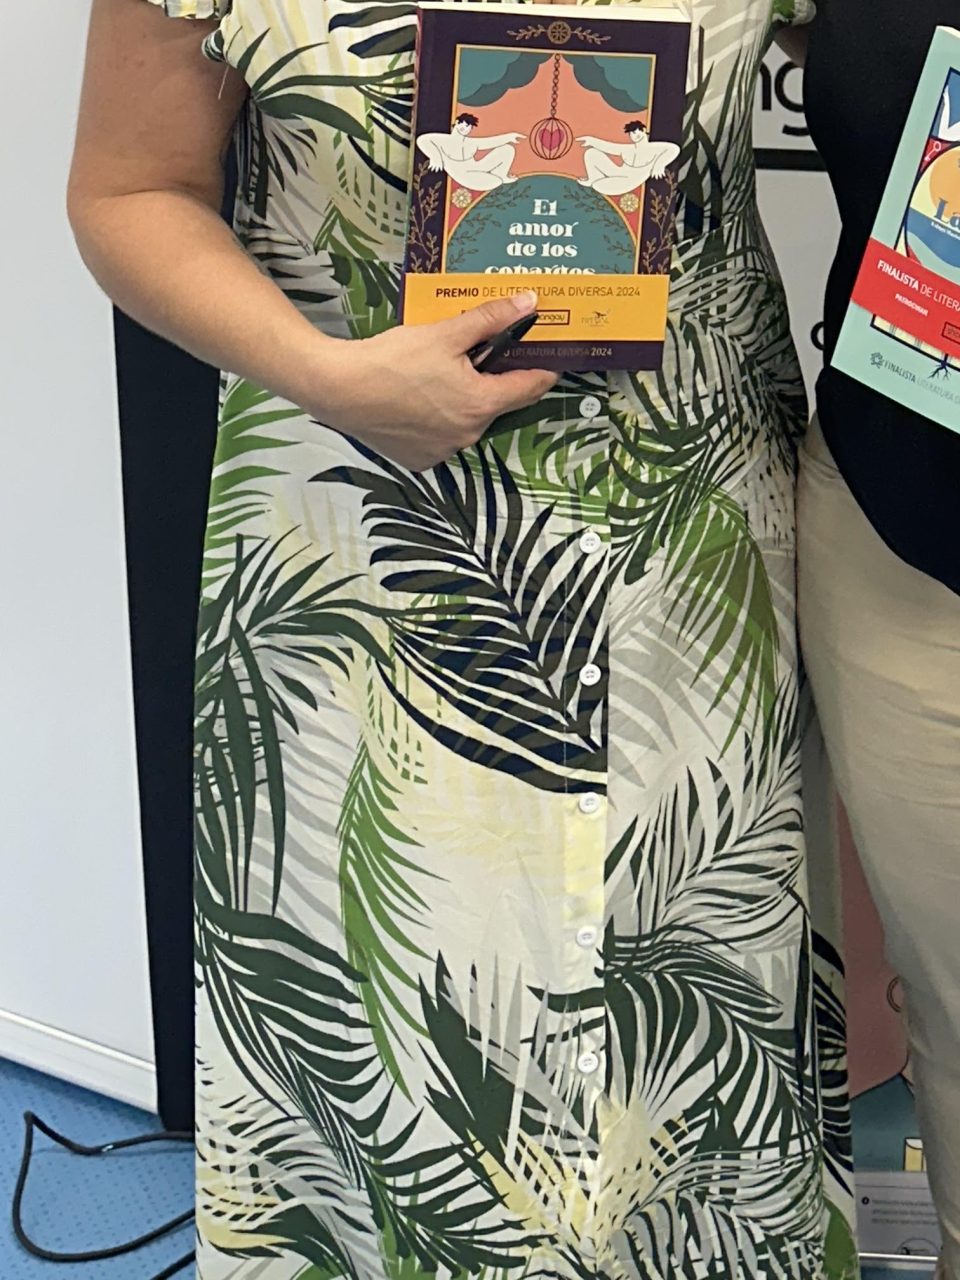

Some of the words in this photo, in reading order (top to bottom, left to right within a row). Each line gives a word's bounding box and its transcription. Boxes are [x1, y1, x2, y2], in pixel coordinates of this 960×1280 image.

[532, 199, 558, 216] El
[508, 222, 579, 238] amor
[506, 242, 536, 257] de
[541, 242, 578, 257] los
[877, 259, 920, 290] FINALISTA
[920, 283, 934, 298] DE
[435, 287, 479, 298] PREMIO
[482, 286, 497, 297] DE
[568, 286, 614, 297] DIVERSA
[615, 286, 641, 297] 2024
[590, 347, 613, 357] 2024
